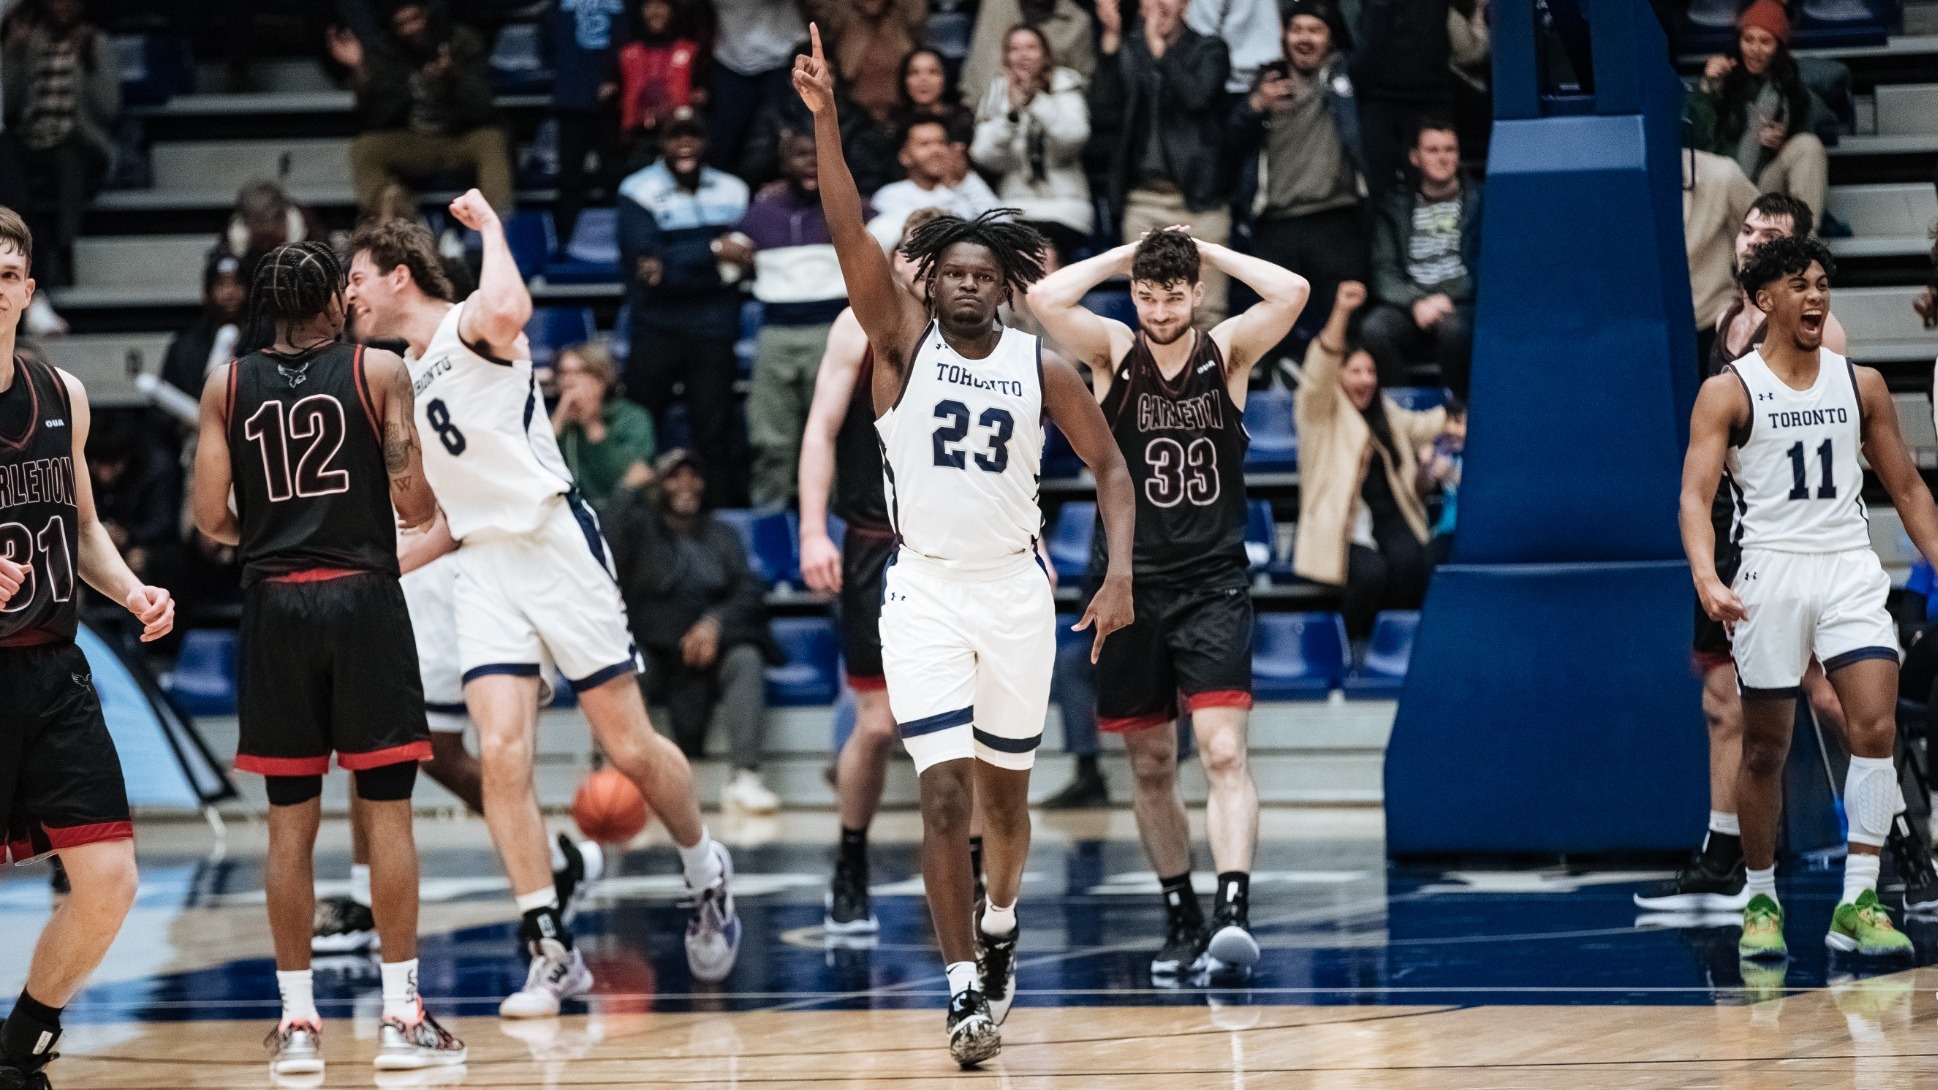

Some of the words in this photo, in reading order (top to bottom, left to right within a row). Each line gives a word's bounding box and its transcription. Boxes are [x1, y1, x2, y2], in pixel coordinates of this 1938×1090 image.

[414, 355, 452, 398] RONTO
[45, 419, 65, 428] OUA
[426, 398, 466, 456] 8
[932, 399, 1015, 474] 23
[1768, 407, 1848, 429] TORONTO
[245, 394, 349, 502] 12
[1145, 437, 1220, 508] 33
[1786, 438, 1837, 500] 11
[0, 457, 77, 509] RLETON
